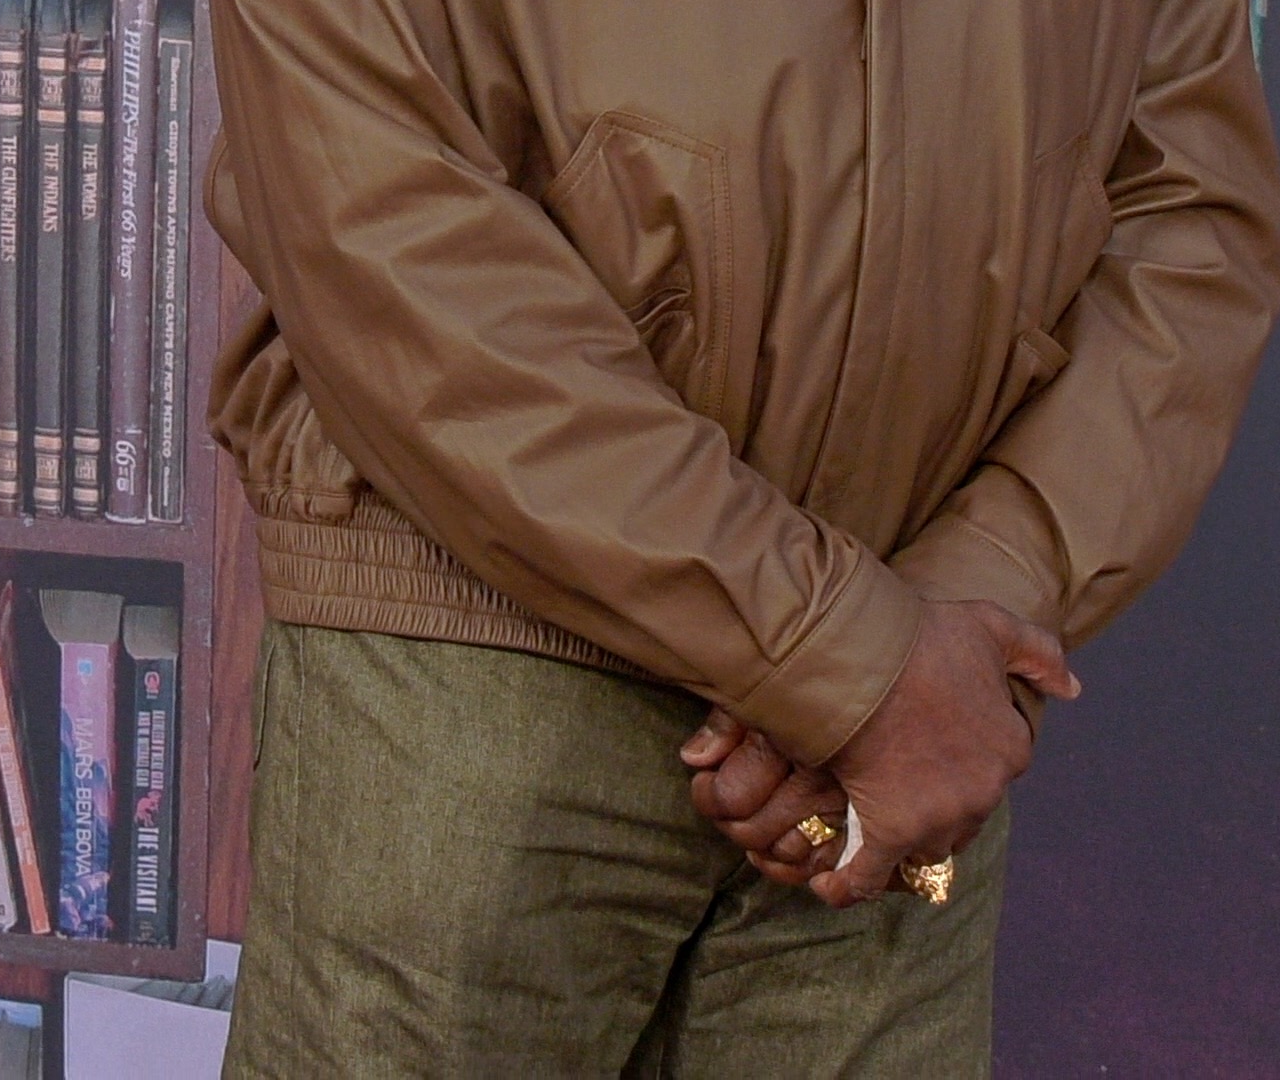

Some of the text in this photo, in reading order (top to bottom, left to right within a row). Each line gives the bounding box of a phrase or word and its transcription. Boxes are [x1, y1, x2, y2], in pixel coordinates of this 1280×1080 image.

[167, 120, 178, 163] GHOST
[0, 136, 17, 263] THE GUNFIGHTERS
[42, 143, 59, 233] THE INDIANS
[81, 143, 98, 221] THE WOMEN
[166, 169, 177, 213] TOWNS
[116, 168, 138, 281] First 66 Years
[166, 215, 176, 246] AND
[165, 248, 175, 299] MINING
[164, 303, 175, 349] CAMPS
[164, 351, 173, 369] OF
[163, 371, 174, 403] NEW
[162, 405, 173, 458] MEXICO
[75, 717, 94, 877] MARS BEN BOVA
[135, 827, 160, 914] THE VISITANT
